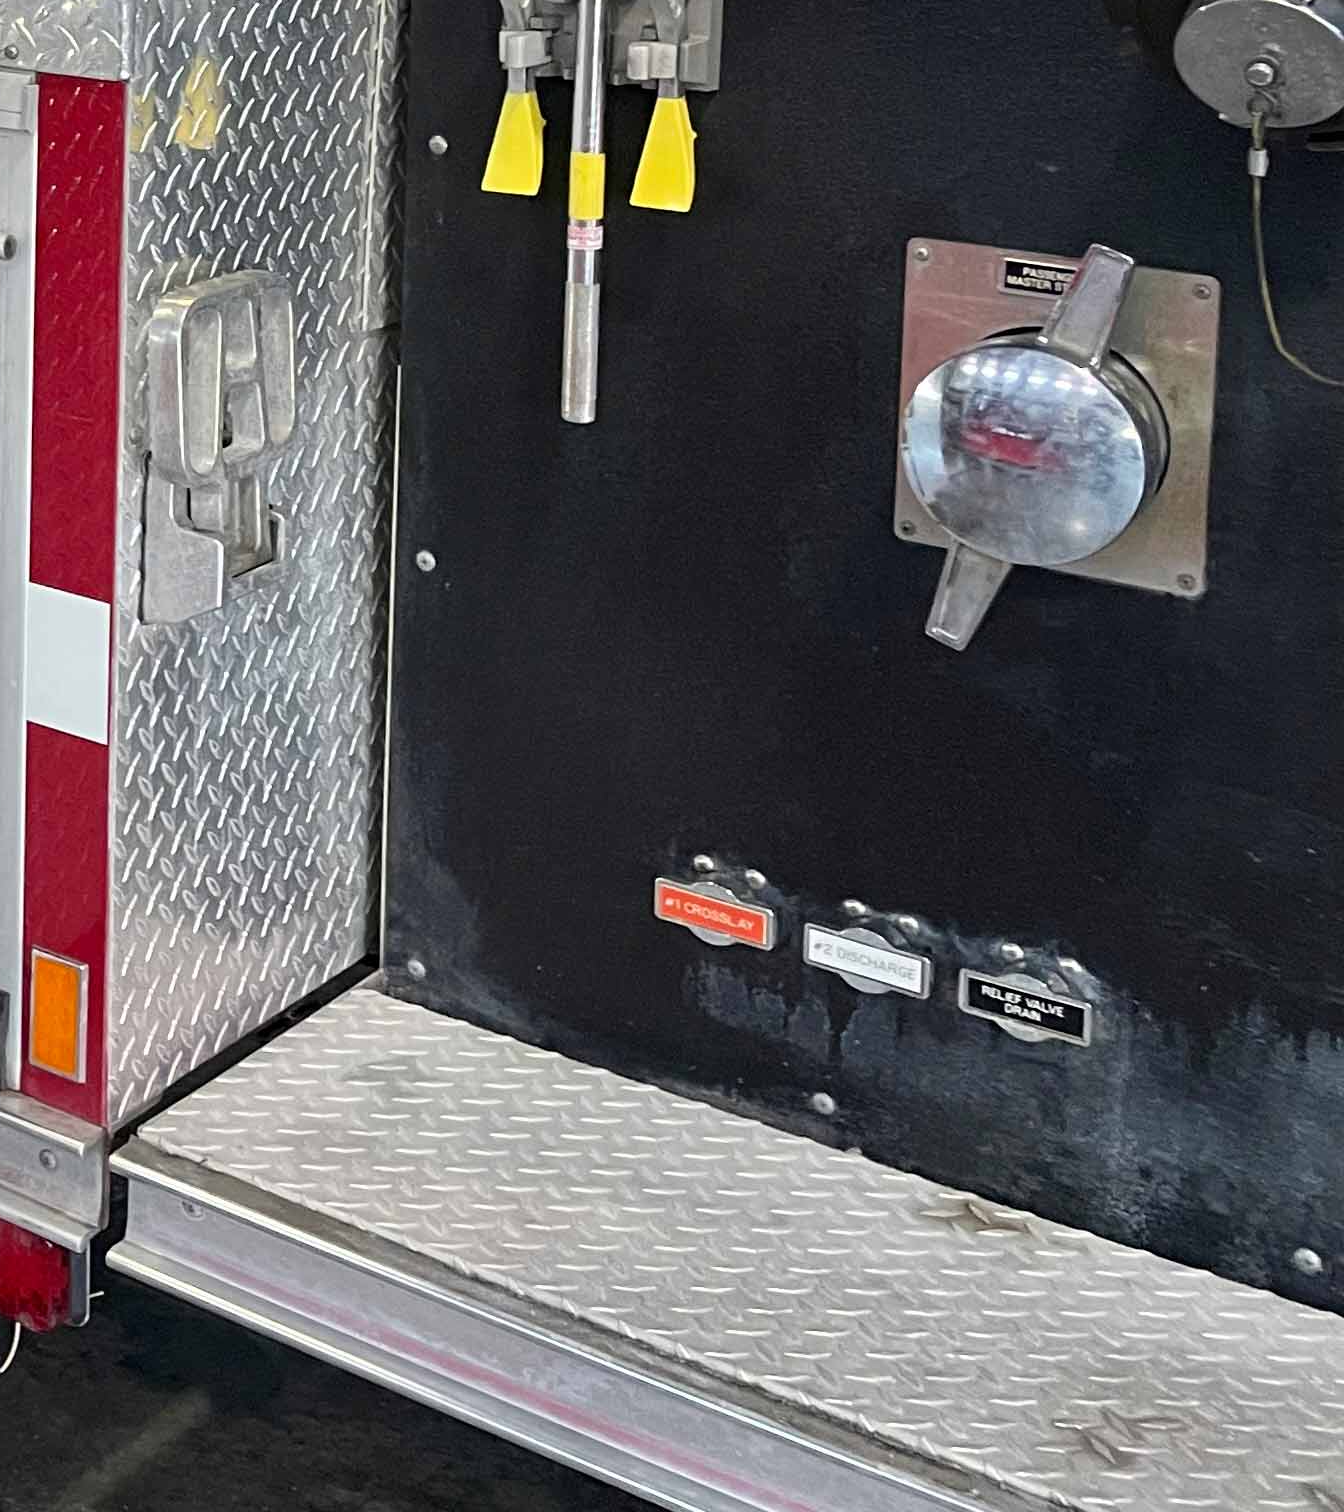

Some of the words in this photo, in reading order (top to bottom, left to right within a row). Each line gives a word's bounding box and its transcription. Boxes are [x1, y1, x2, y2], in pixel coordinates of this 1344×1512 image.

[1007, 275, 1052, 290] MASTER
[1022, 267, 1073, 282] PASSENG
[665, 898, 681, 909] #1
[683, 902, 755, 930] CROSSLAY
[814, 943, 833, 955] #2
[837, 946, 917, 980] DISCHARGE
[981, 984, 1022, 1004] RELIEF
[1025, 998, 1065, 1018] VALVE
[1004, 1003, 1042, 1022] DRAIN
